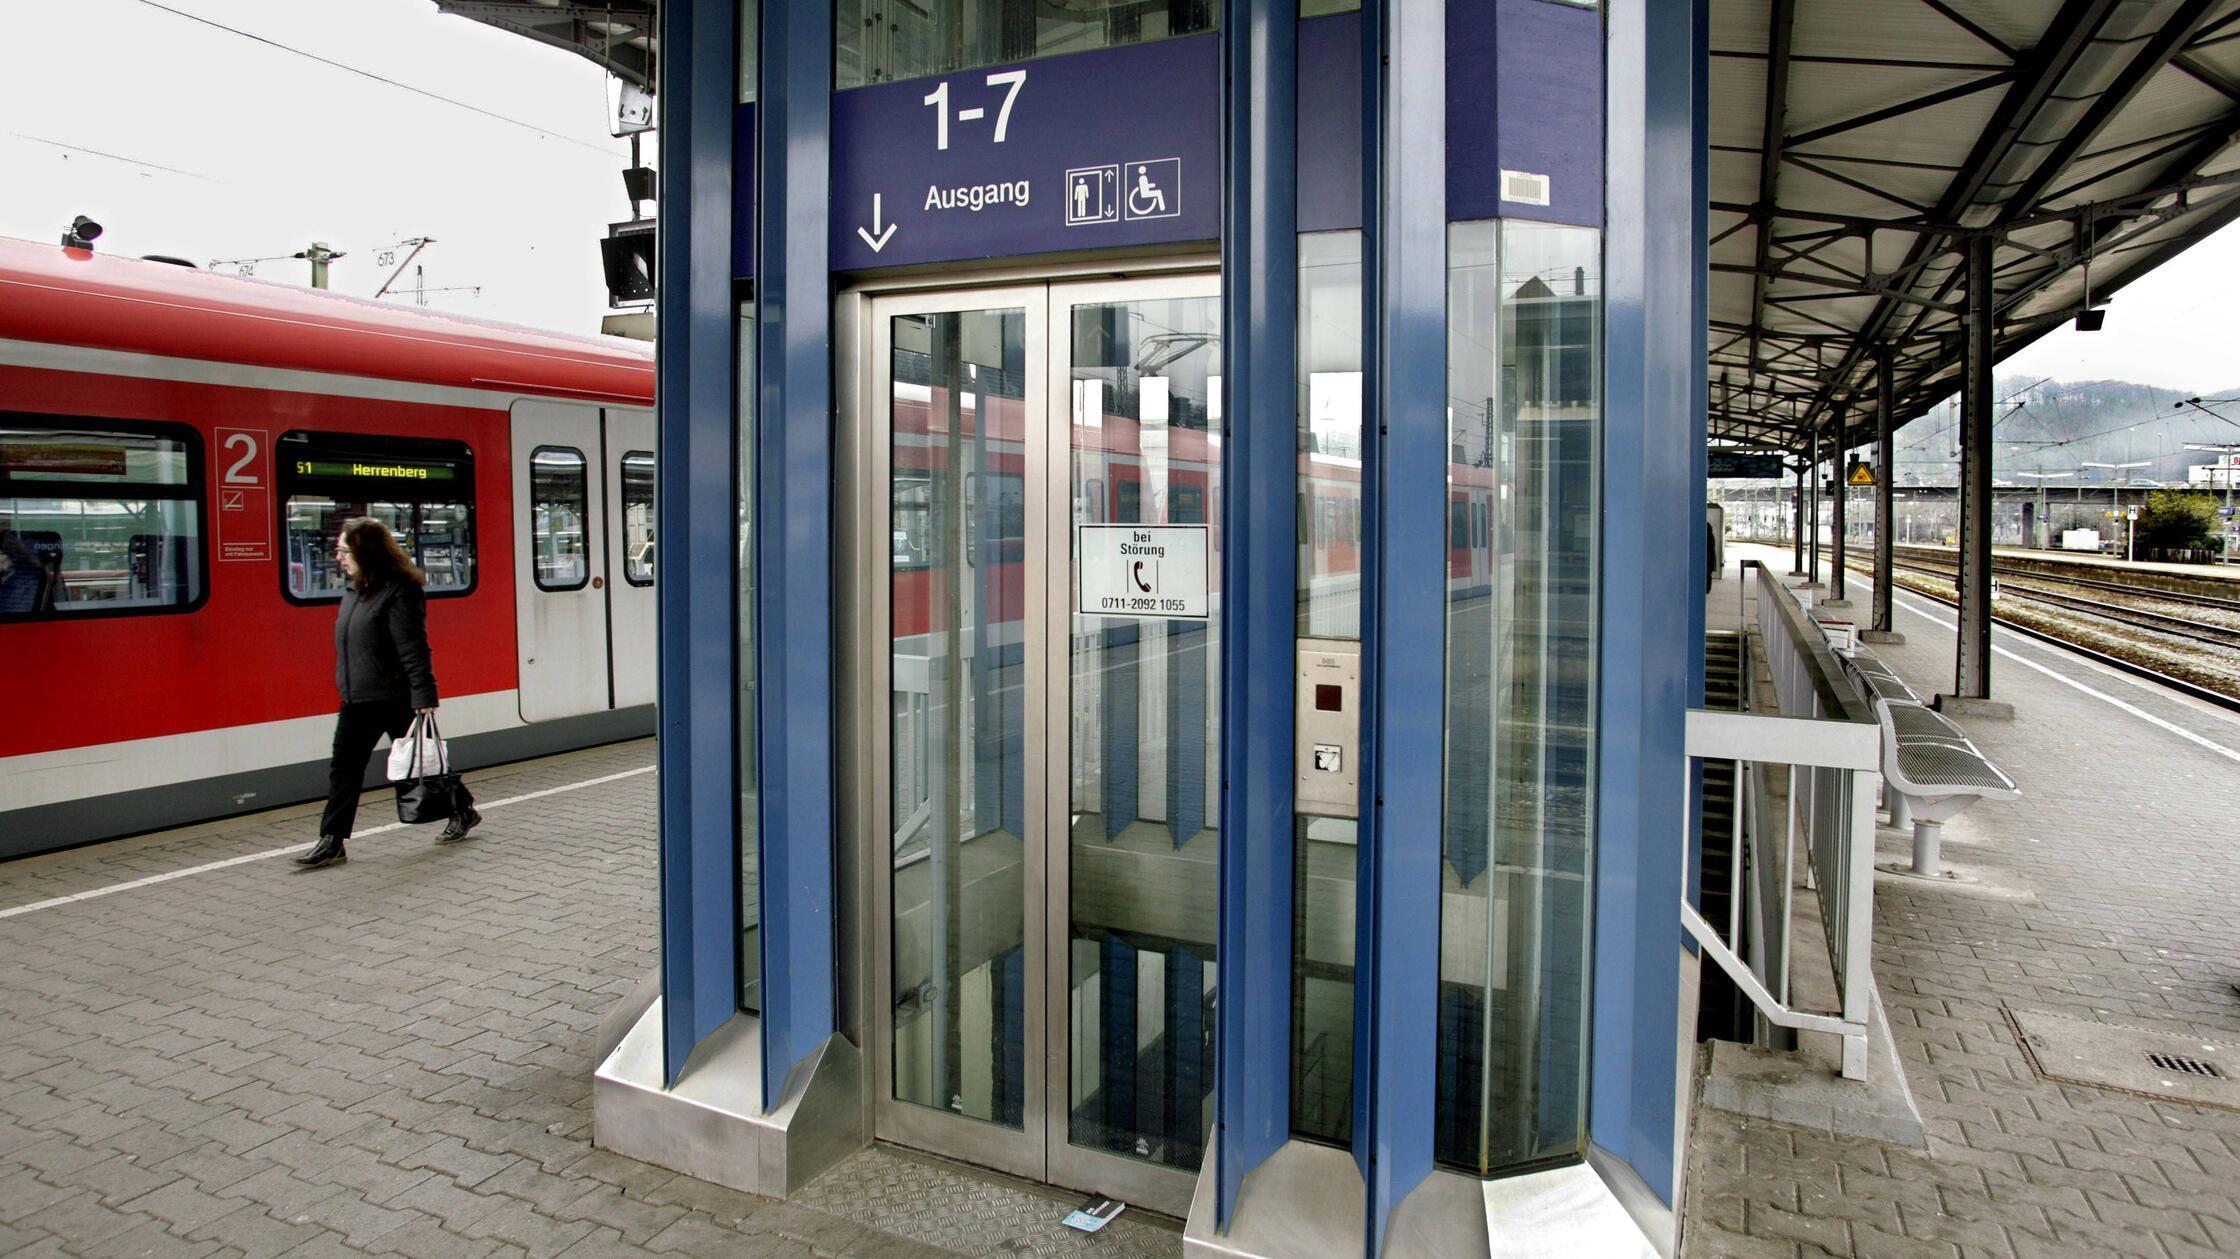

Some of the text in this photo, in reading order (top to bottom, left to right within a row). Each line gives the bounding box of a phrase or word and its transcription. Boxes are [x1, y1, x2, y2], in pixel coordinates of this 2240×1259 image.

[924, 69, 1027, 150] 1-7
[924, 180, 1030, 212] Ausgang
[377, 252, 395, 267] 673
[224, 433, 258, 484] 2
[296, 461, 427, 479] S1 Herrenberg
[1133, 531, 1151, 542] bei
[1120, 543, 1165, 558] Störung
[1101, 597, 1185, 611] 0711-2092 1055
